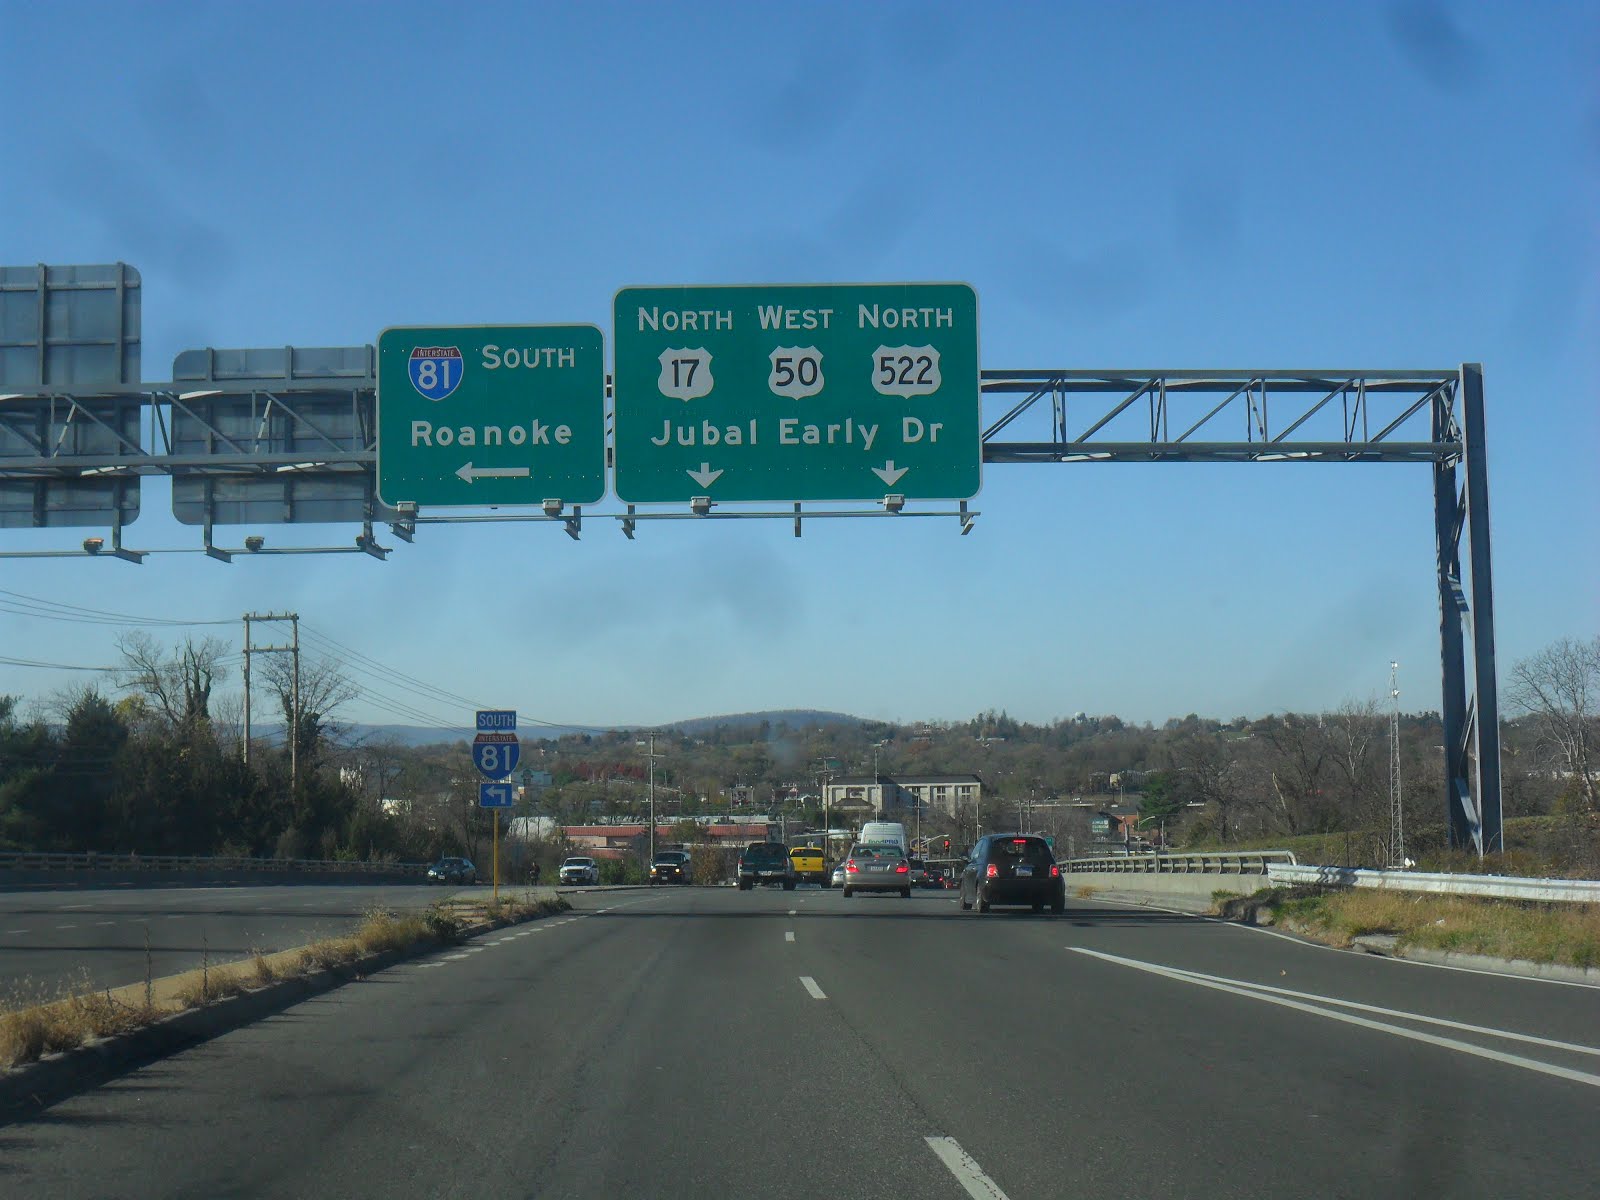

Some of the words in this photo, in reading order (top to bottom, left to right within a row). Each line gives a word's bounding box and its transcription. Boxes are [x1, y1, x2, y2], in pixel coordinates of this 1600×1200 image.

[638, 306, 733, 331] NORTH
[757, 305, 834, 330] WEST
[858, 304, 953, 329] NORTH
[482, 344, 575, 369] SOUTH
[418, 360, 450, 390] 81
[671, 359, 700, 388] 17
[775, 357, 818, 387] 50
[880, 356, 933, 386] 522
[411, 418, 572, 447] Roanoke
[651, 418, 757, 446] Jubal
[779, 417, 879, 450] Early
[903, 416, 944, 443] Dr
[479, 714, 515, 727] SOUTH
[481, 745, 511, 771] 81
